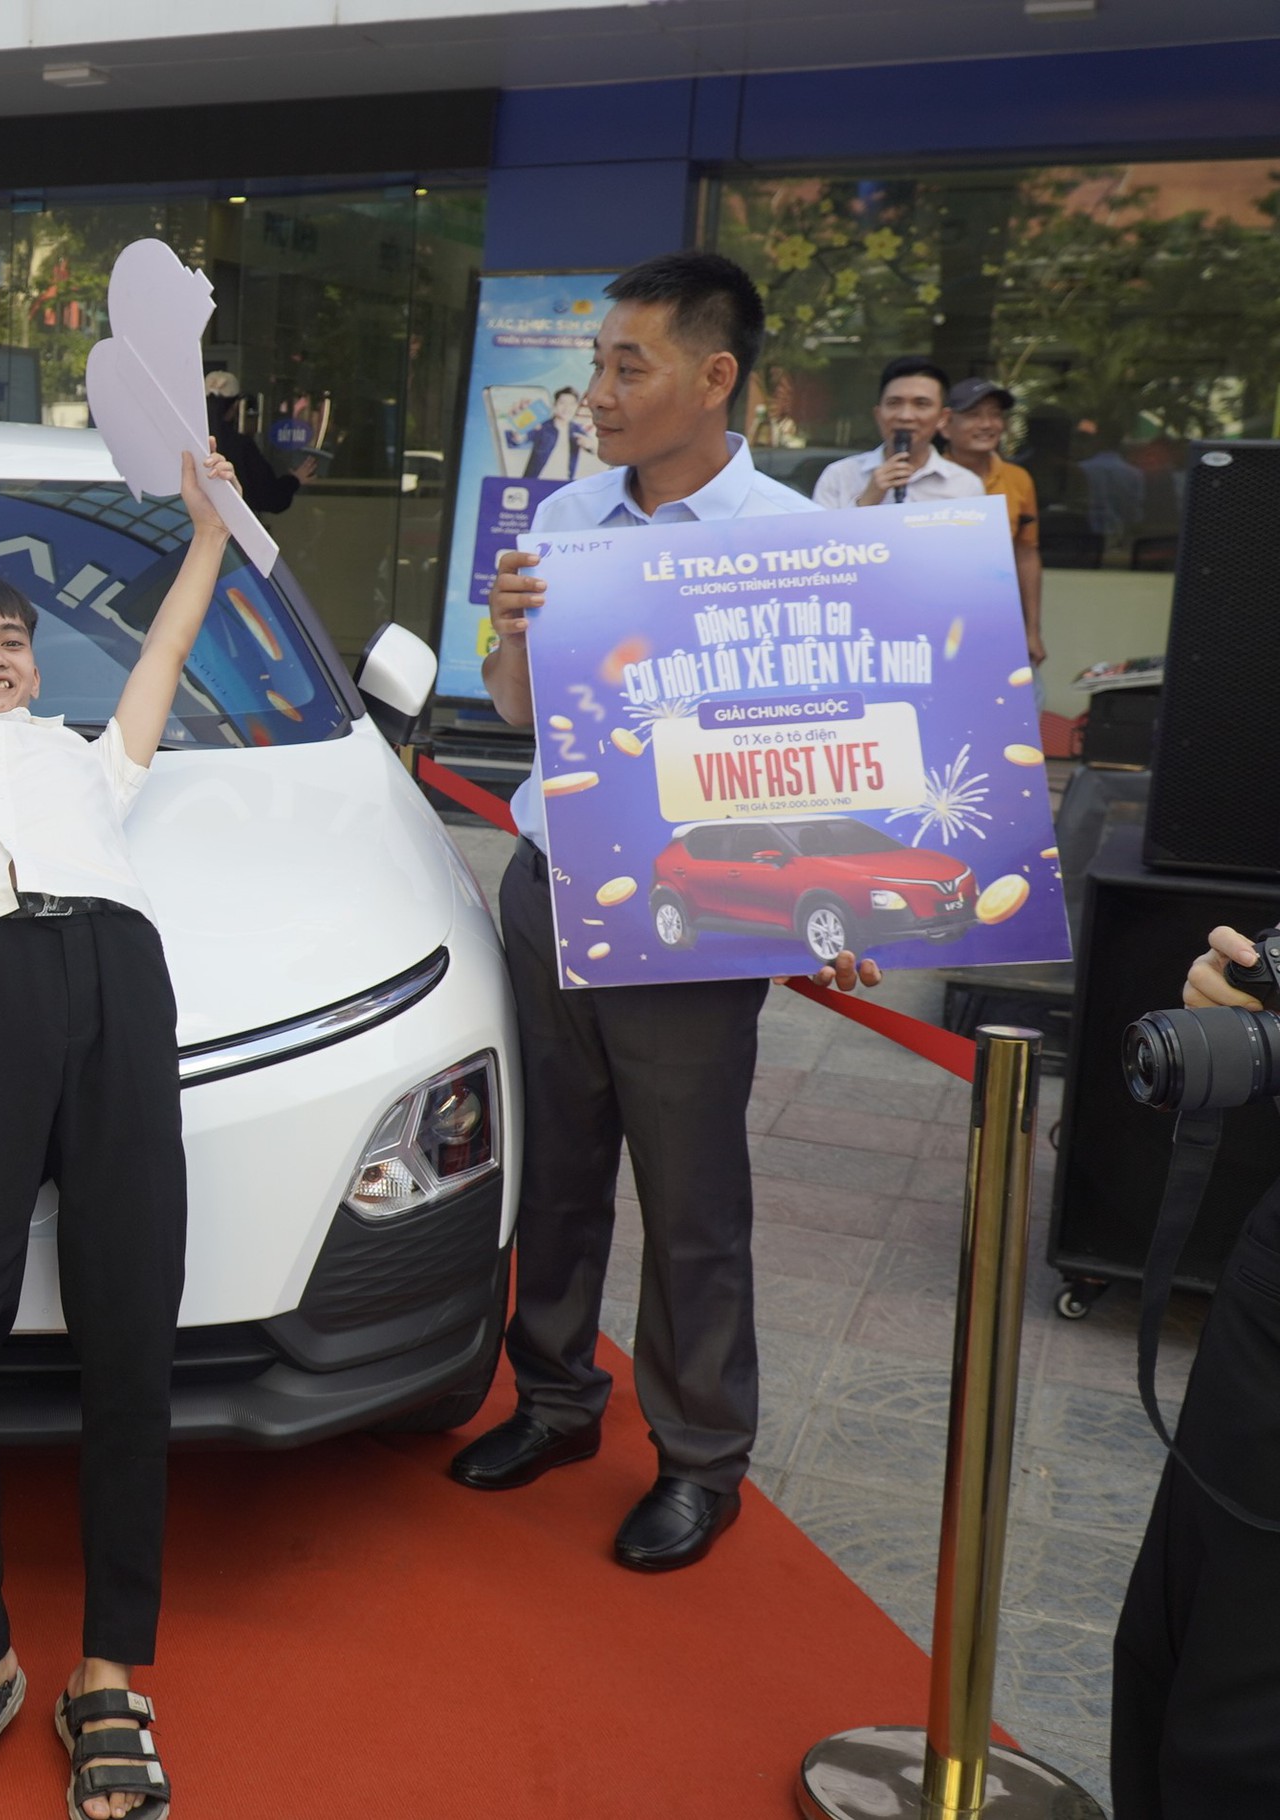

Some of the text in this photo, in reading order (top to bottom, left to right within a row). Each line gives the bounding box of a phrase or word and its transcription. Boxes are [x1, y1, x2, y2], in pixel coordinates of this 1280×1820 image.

[557, 541, 613, 554] VNPT
[642, 539, 891, 582] LỄ TRAO THƯỞNG
[680, 572, 858, 596] CHƯƠNG TRÌNH KHUYẾN MẠI
[693, 595, 852, 647] ĐĂNG KÝ THẢ GA
[623, 658, 659, 705] CƠ
[701, 643, 742, 694] LÁI
[741, 633, 779, 689] XẾ
[780, 636, 840, 691] ĐIỆN
[842, 628, 876, 684] VỀ
[881, 634, 932, 685] NHÀ
[714, 699, 849, 722] GIẢI CHUNG CUỘC
[733, 728, 837, 746] 01 Xe ô tô điện
[693, 741, 885, 802] VINFAST VF5
[770, 798, 829, 810] 529.000.000
